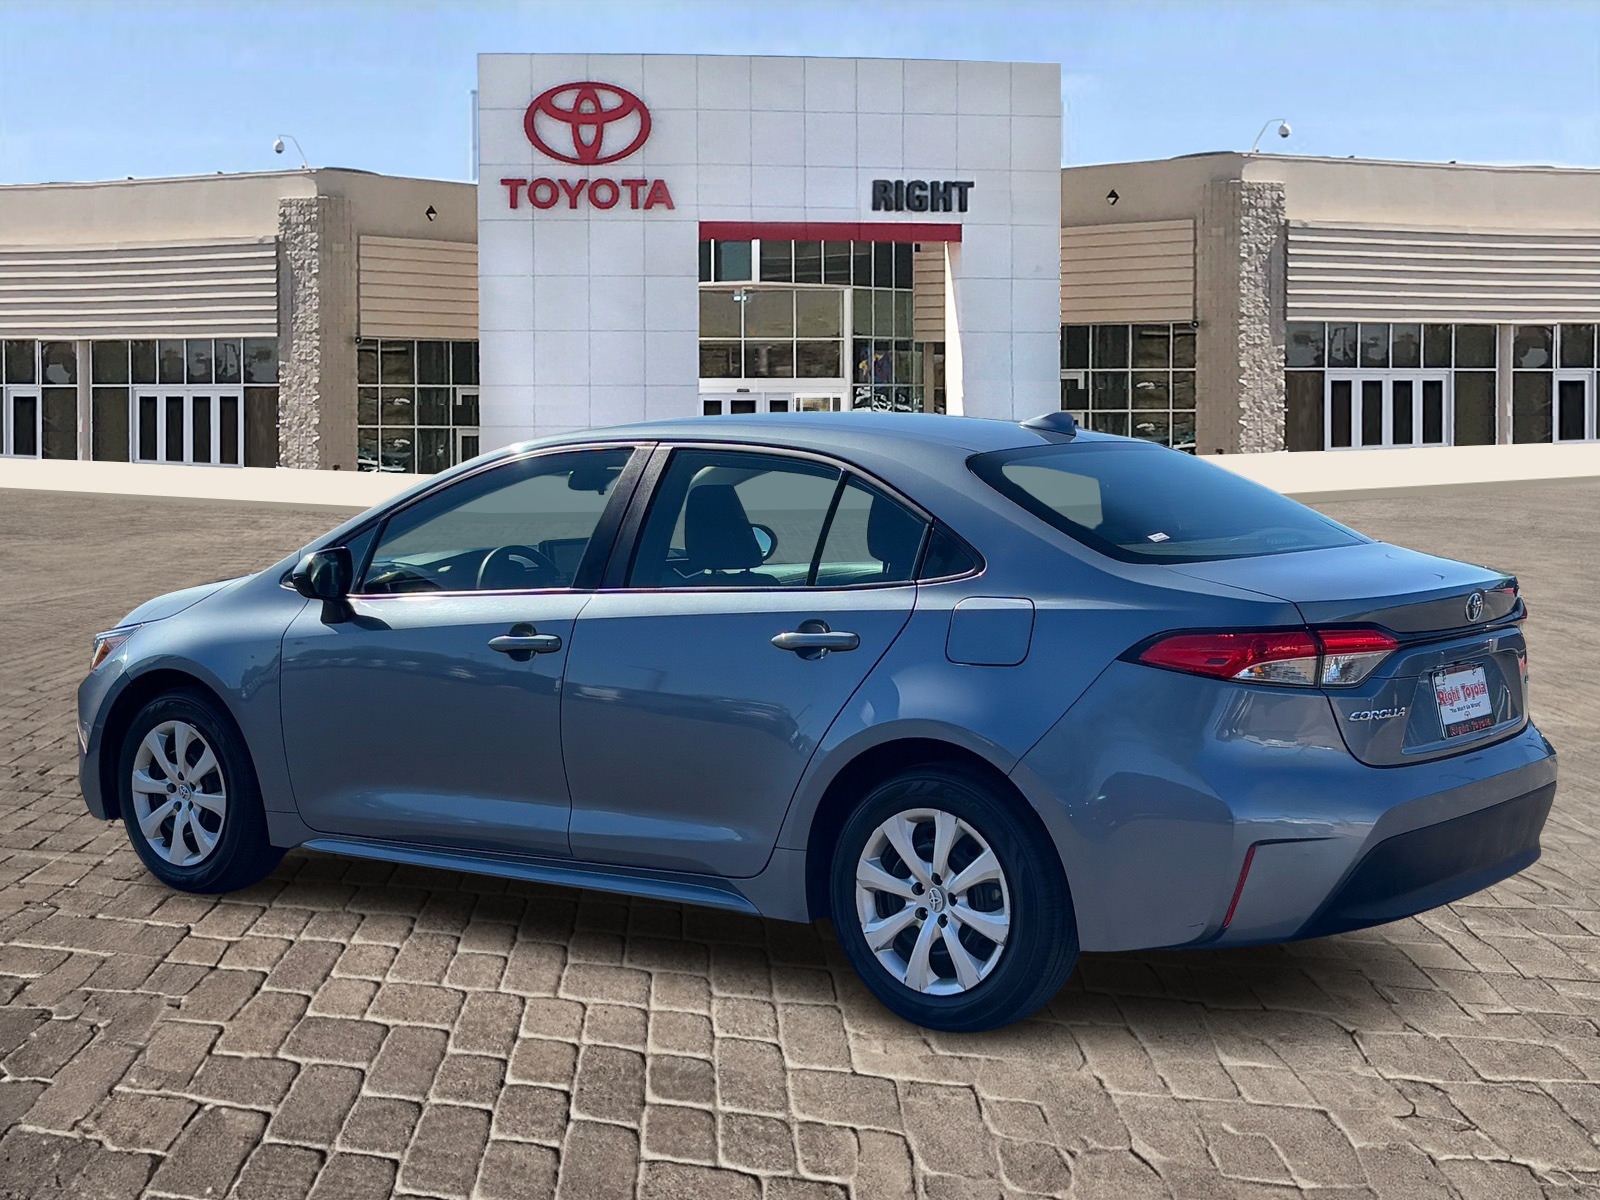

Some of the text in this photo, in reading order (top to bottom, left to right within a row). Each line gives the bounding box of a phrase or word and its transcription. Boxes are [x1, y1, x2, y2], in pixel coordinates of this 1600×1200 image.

[500, 178, 675, 211] TOYOTA
[872, 179, 974, 213] RIGHT
[1437, 681, 1487, 707] Right Toyota
[1349, 706, 1406, 722] COROLLA
[1449, 718, 1492, 736] Right Toyota
